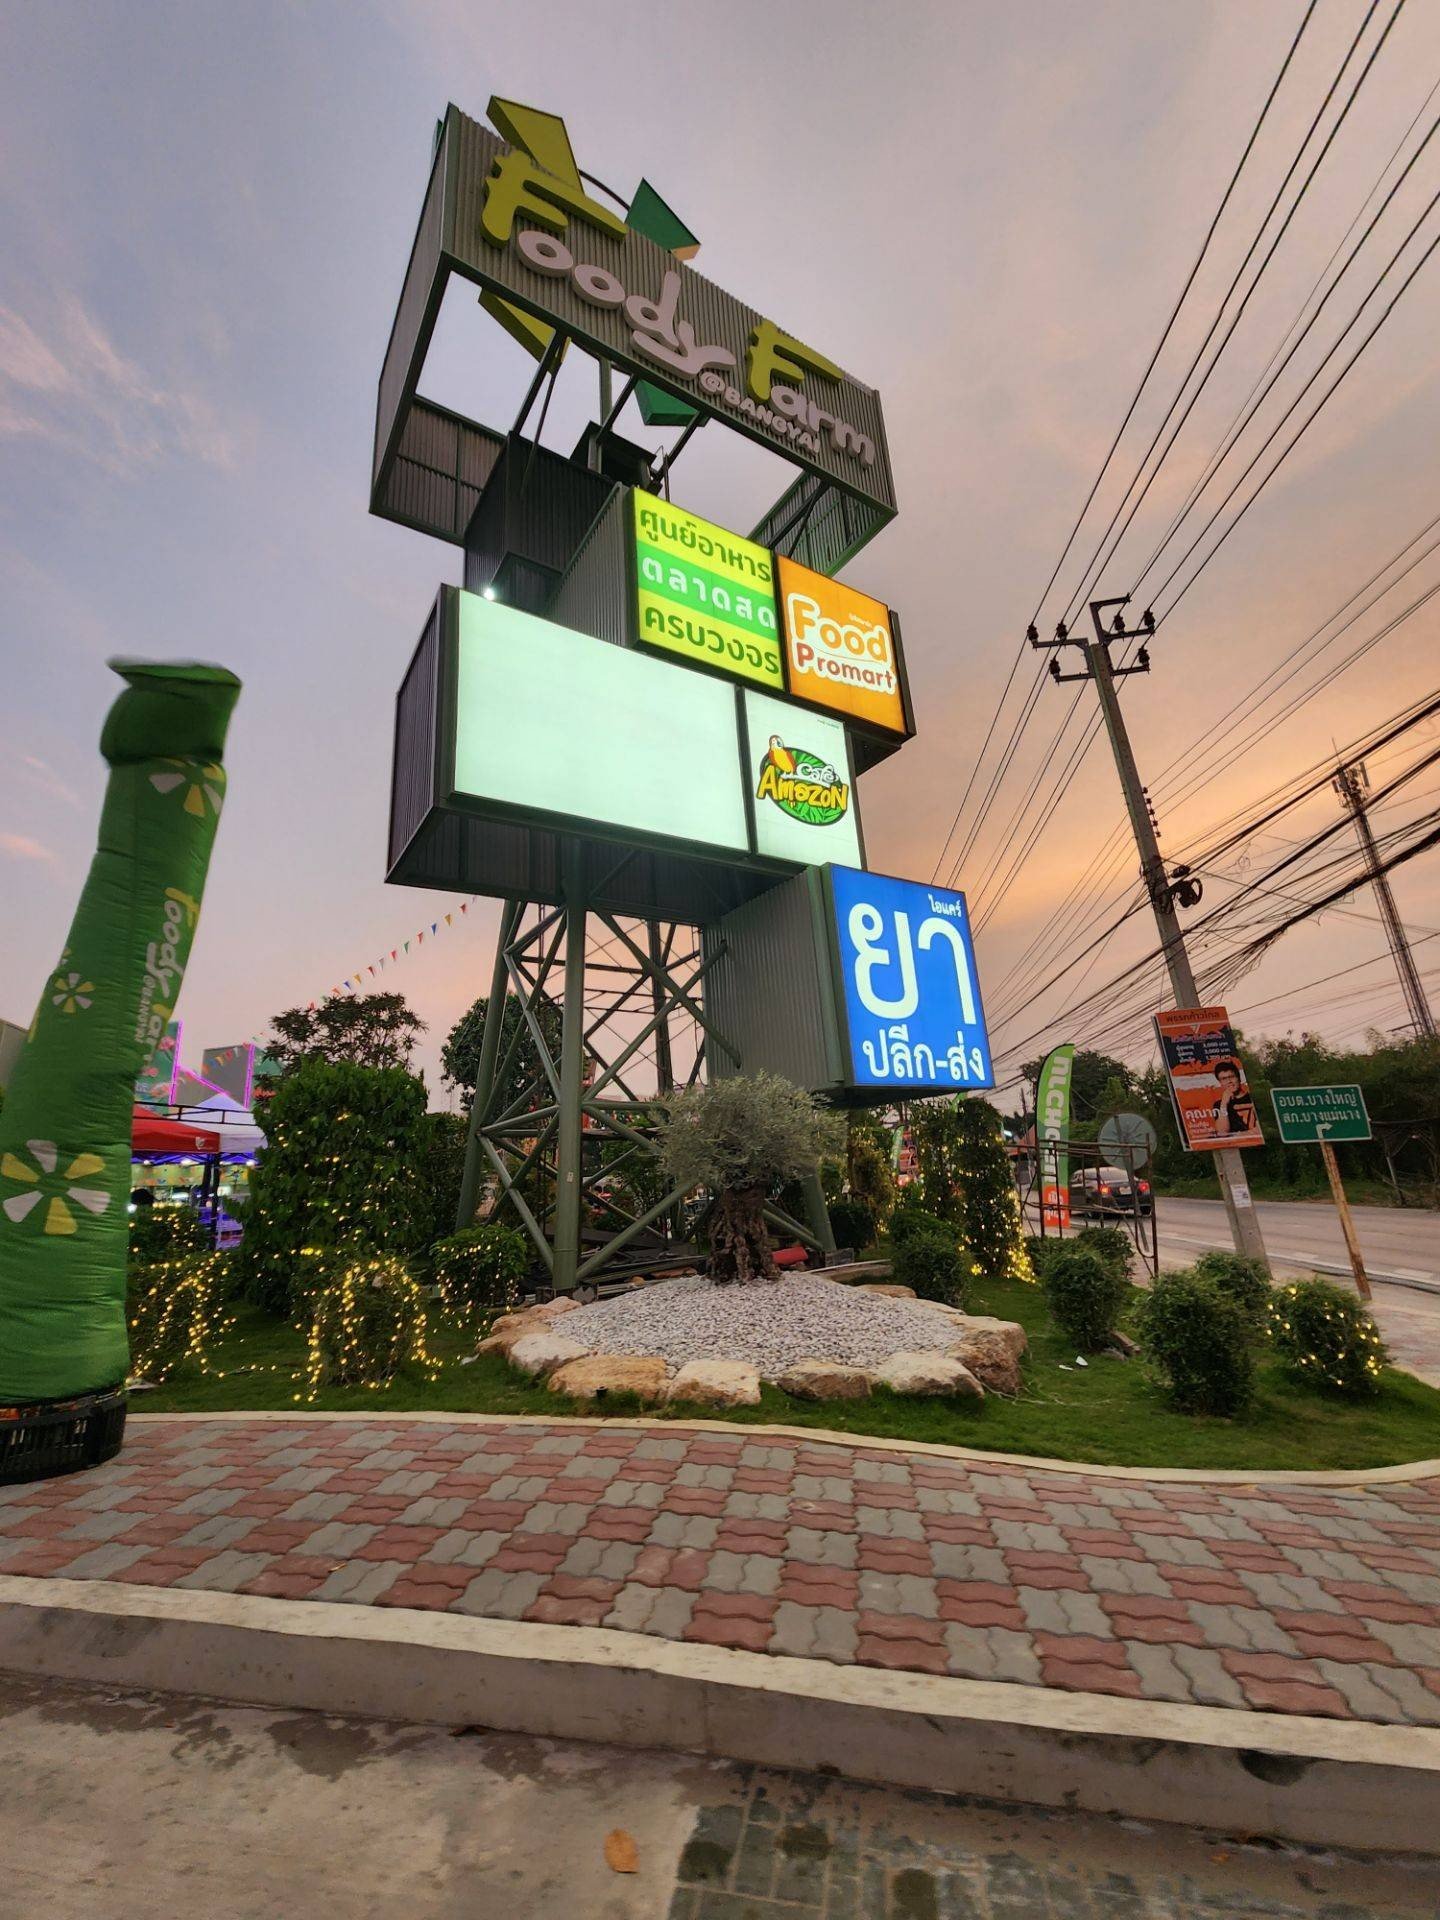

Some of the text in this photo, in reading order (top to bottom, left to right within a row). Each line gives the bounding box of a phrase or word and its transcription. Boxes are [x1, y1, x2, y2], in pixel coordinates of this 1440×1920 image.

[481, 149, 876, 470] Foody Farm
[699, 371, 821, 456] @BANGYAI
[640, 508, 771, 583] ศูนย์อาหาร
[642, 555, 777, 630] ตลาดสด
[645, 606, 780, 675] ครบวงจร
[790, 596, 888, 663] Food
[796, 642, 896, 690] Promart
[848, 902, 976, 1025] ยา
[862, 1023, 985, 1081] ปลีก-ส่ง
[1278, 1088, 1358, 1107] อบต.บางใหญ่
